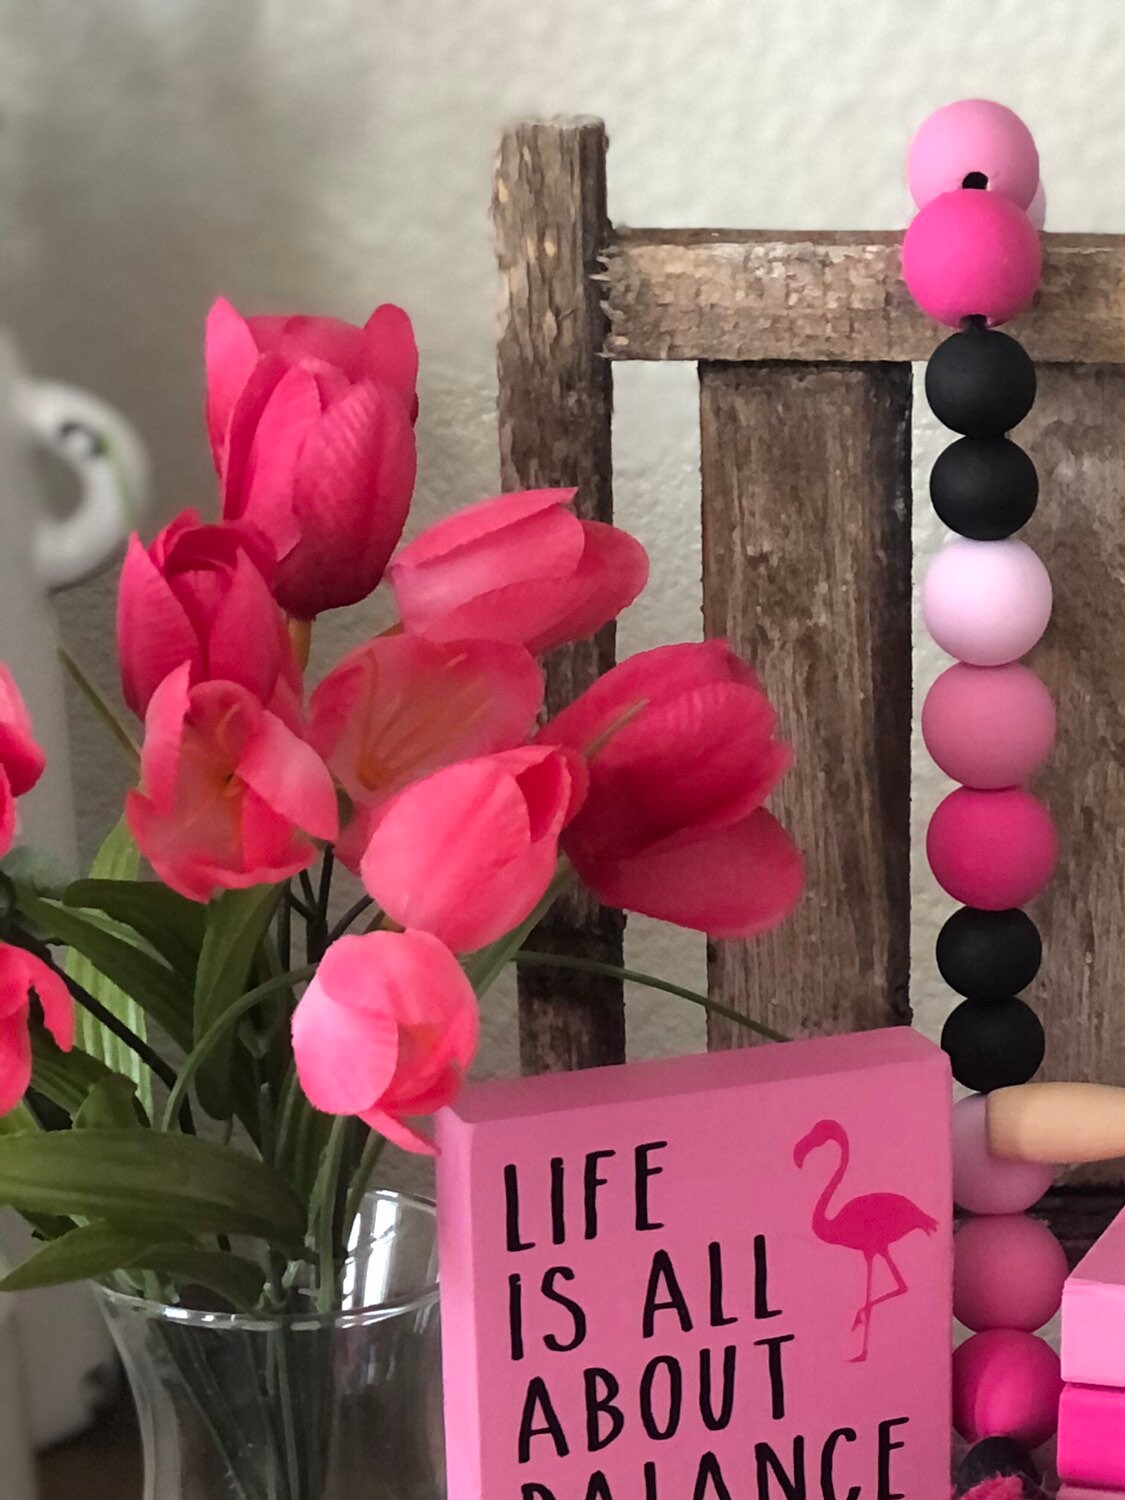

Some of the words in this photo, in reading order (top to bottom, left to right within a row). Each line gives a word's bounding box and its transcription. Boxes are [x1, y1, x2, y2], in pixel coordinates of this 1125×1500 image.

[504, 1140, 667, 1252] LIFE
[508, 1266, 587, 1361] IS
[643, 1234, 782, 1338] ALL
[518, 1334, 794, 1463] ABOUT
